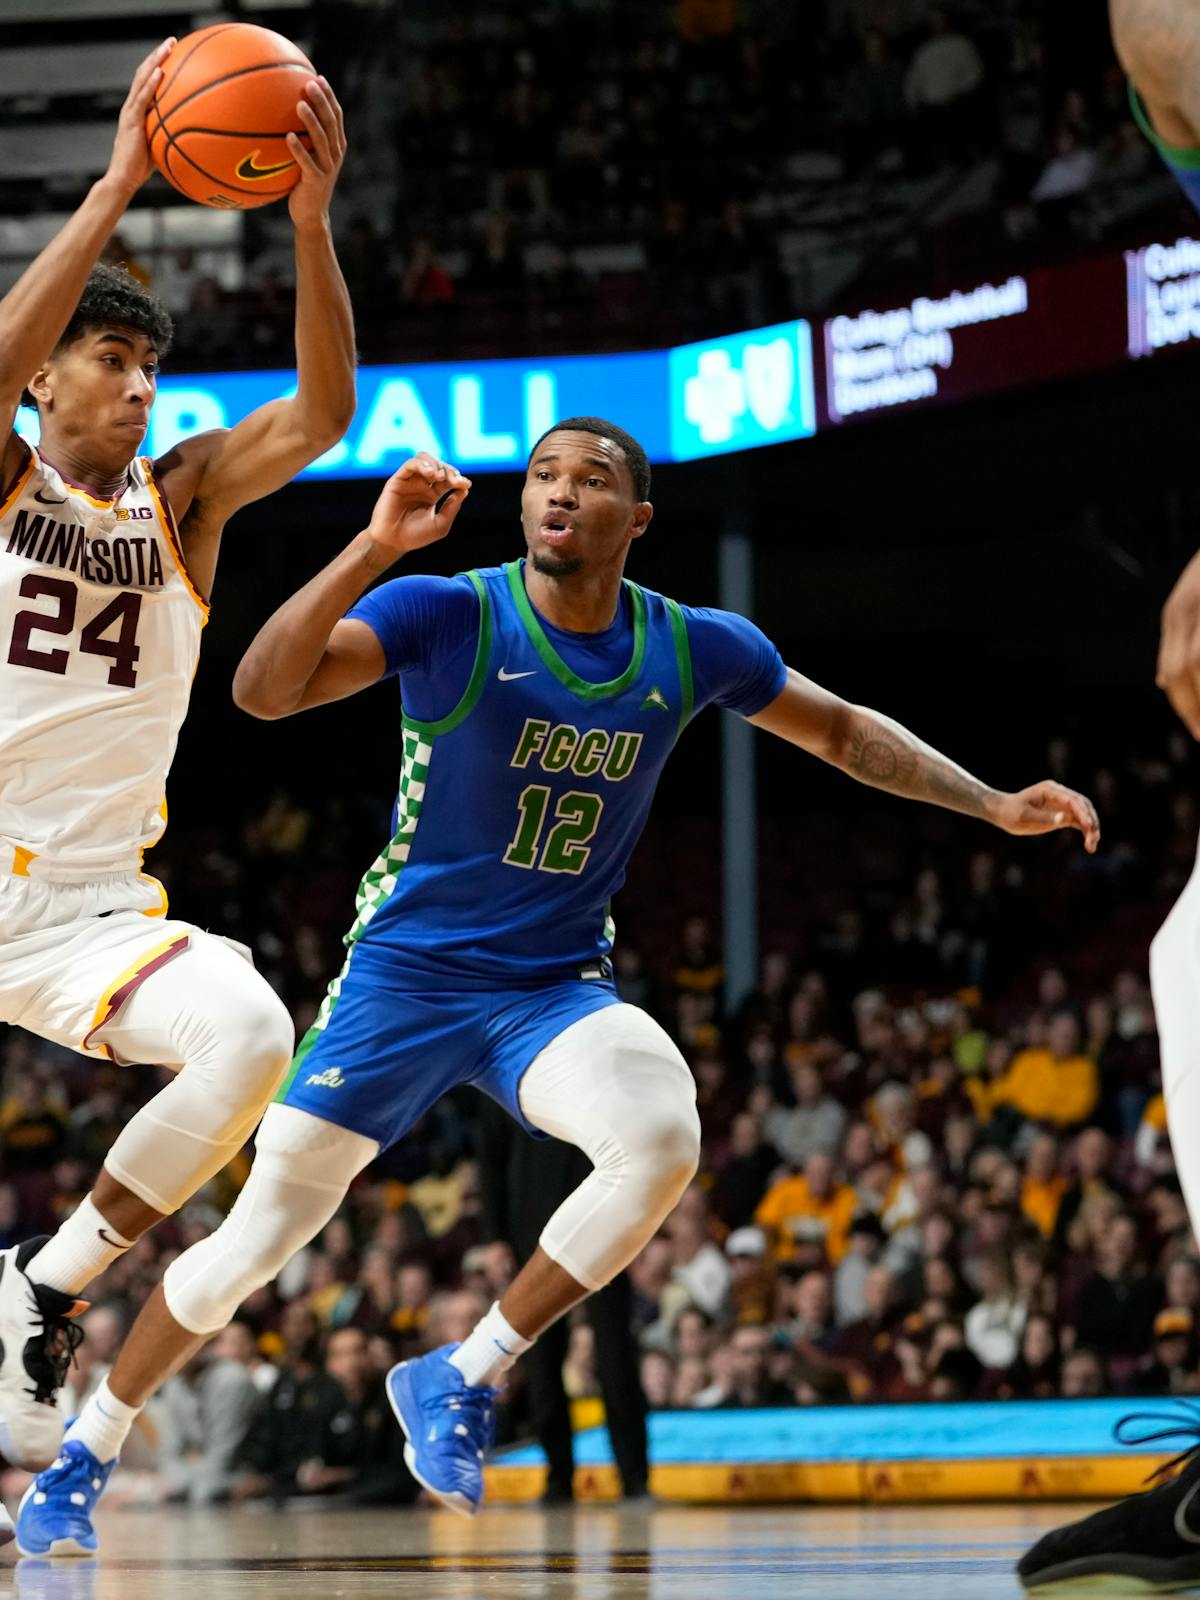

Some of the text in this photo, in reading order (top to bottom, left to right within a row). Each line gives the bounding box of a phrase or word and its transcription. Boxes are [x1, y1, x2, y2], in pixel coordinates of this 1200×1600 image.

[5, 510, 164, 586] MINNESOTA
[7, 573, 142, 688] 24
[510, 717, 643, 782] FGCU
[502, 784, 603, 875] 12
